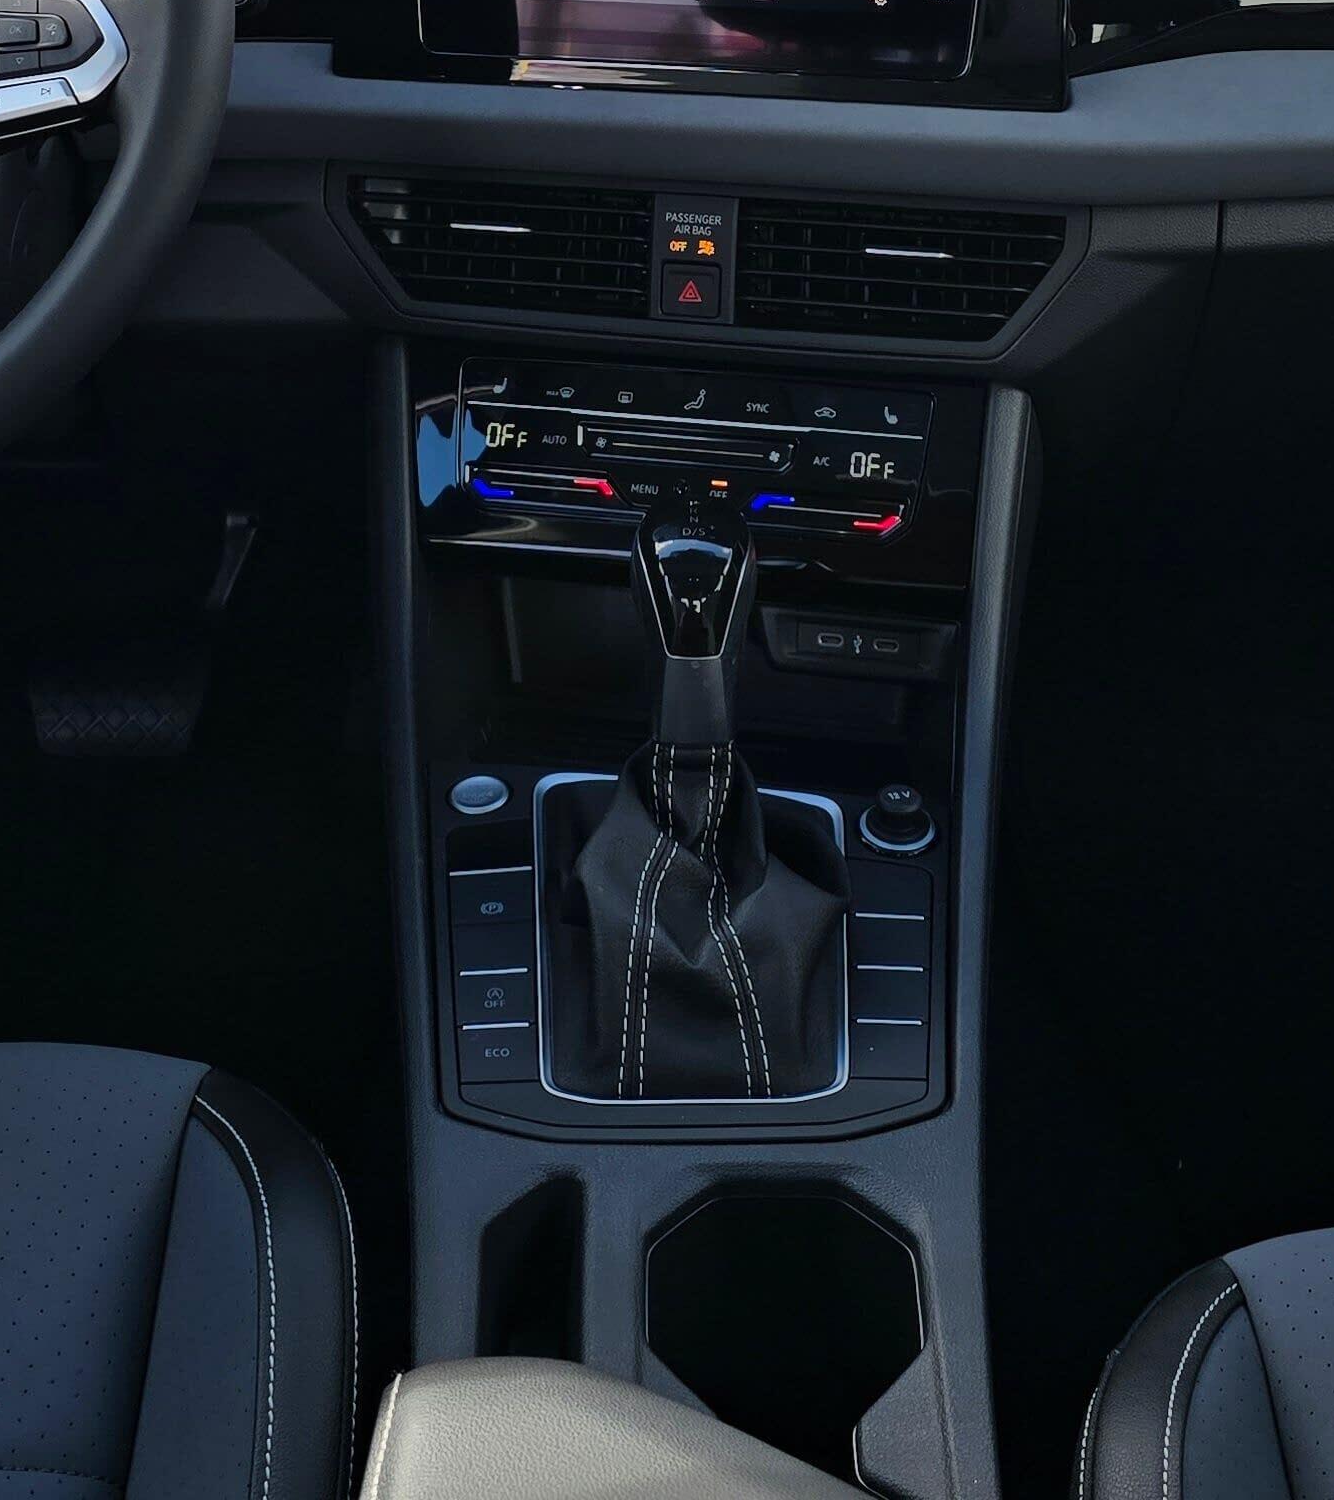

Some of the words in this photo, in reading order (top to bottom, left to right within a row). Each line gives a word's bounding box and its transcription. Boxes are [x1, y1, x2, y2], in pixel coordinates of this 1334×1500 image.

[10, 25, 22, 34] OK
[666, 212, 722, 225] PASSENGER
[674, 225, 690, 234] AIR
[693, 226, 712, 236] BAG
[669, 240, 688, 252] OFF
[746, 403, 769, 413] SYNC
[542, 435, 567, 445] AUTO
[813, 456, 830, 466] A/C
[631, 484, 659, 495] MENU
[683, 528, 706, 536] D/S
[887, 792, 900, 800] 12
[484, 1000, 505, 1008] OFF
[485, 1048, 510, 1058] ECO
